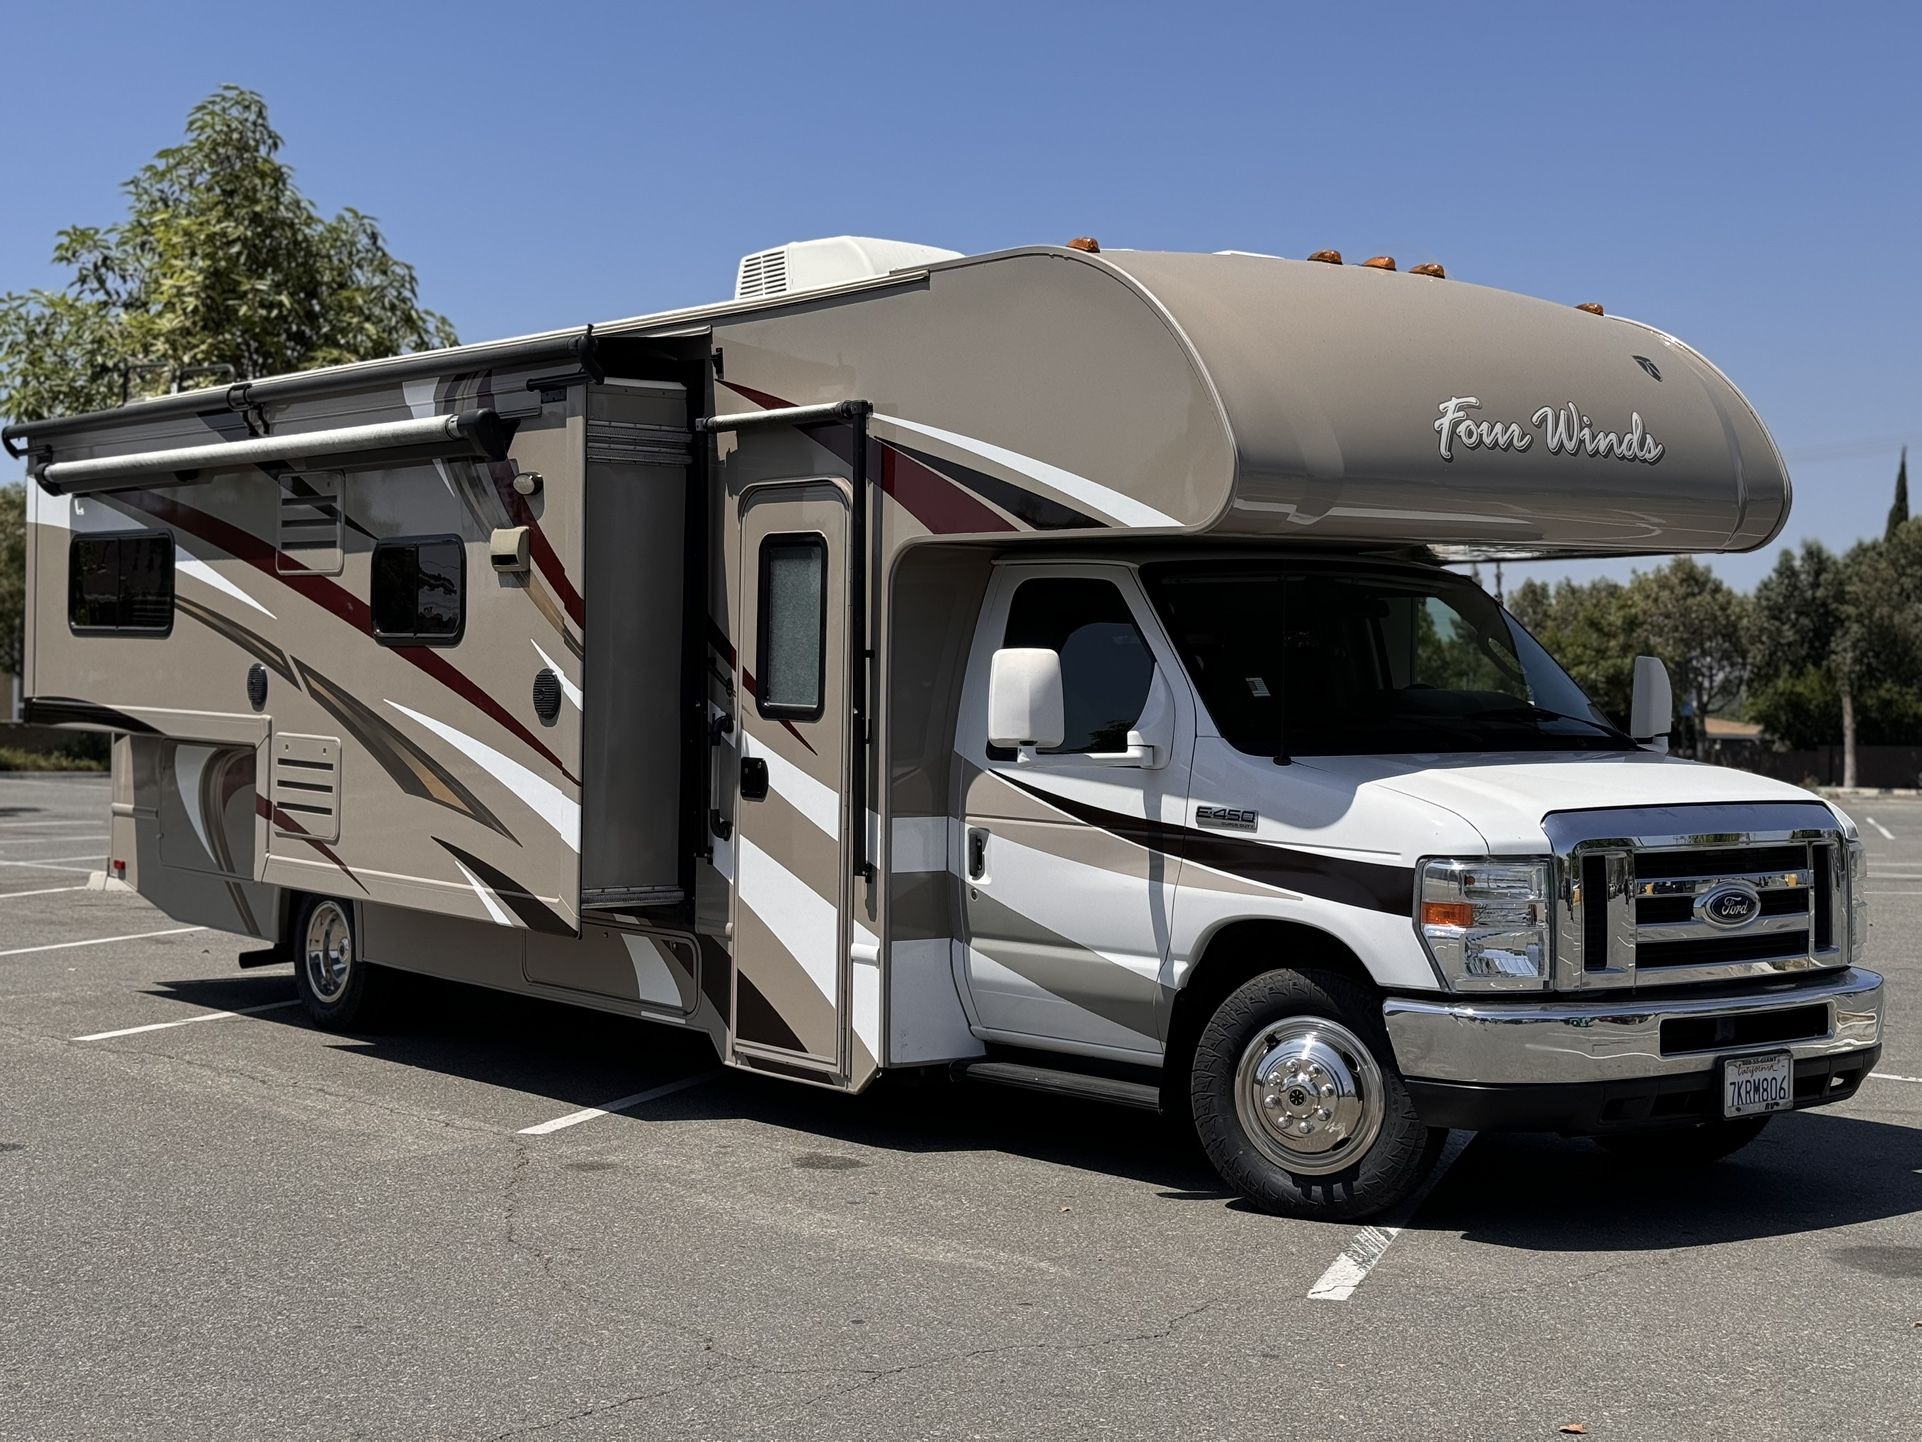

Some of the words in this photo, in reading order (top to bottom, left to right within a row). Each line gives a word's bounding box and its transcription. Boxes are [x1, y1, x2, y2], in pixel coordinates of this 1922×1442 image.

[1433, 396, 1533, 462] Four
[1531, 400, 1665, 465] Winds
[1722, 896, 1749, 915] Ford
[1729, 1075, 1786, 1107] 7KRM806
